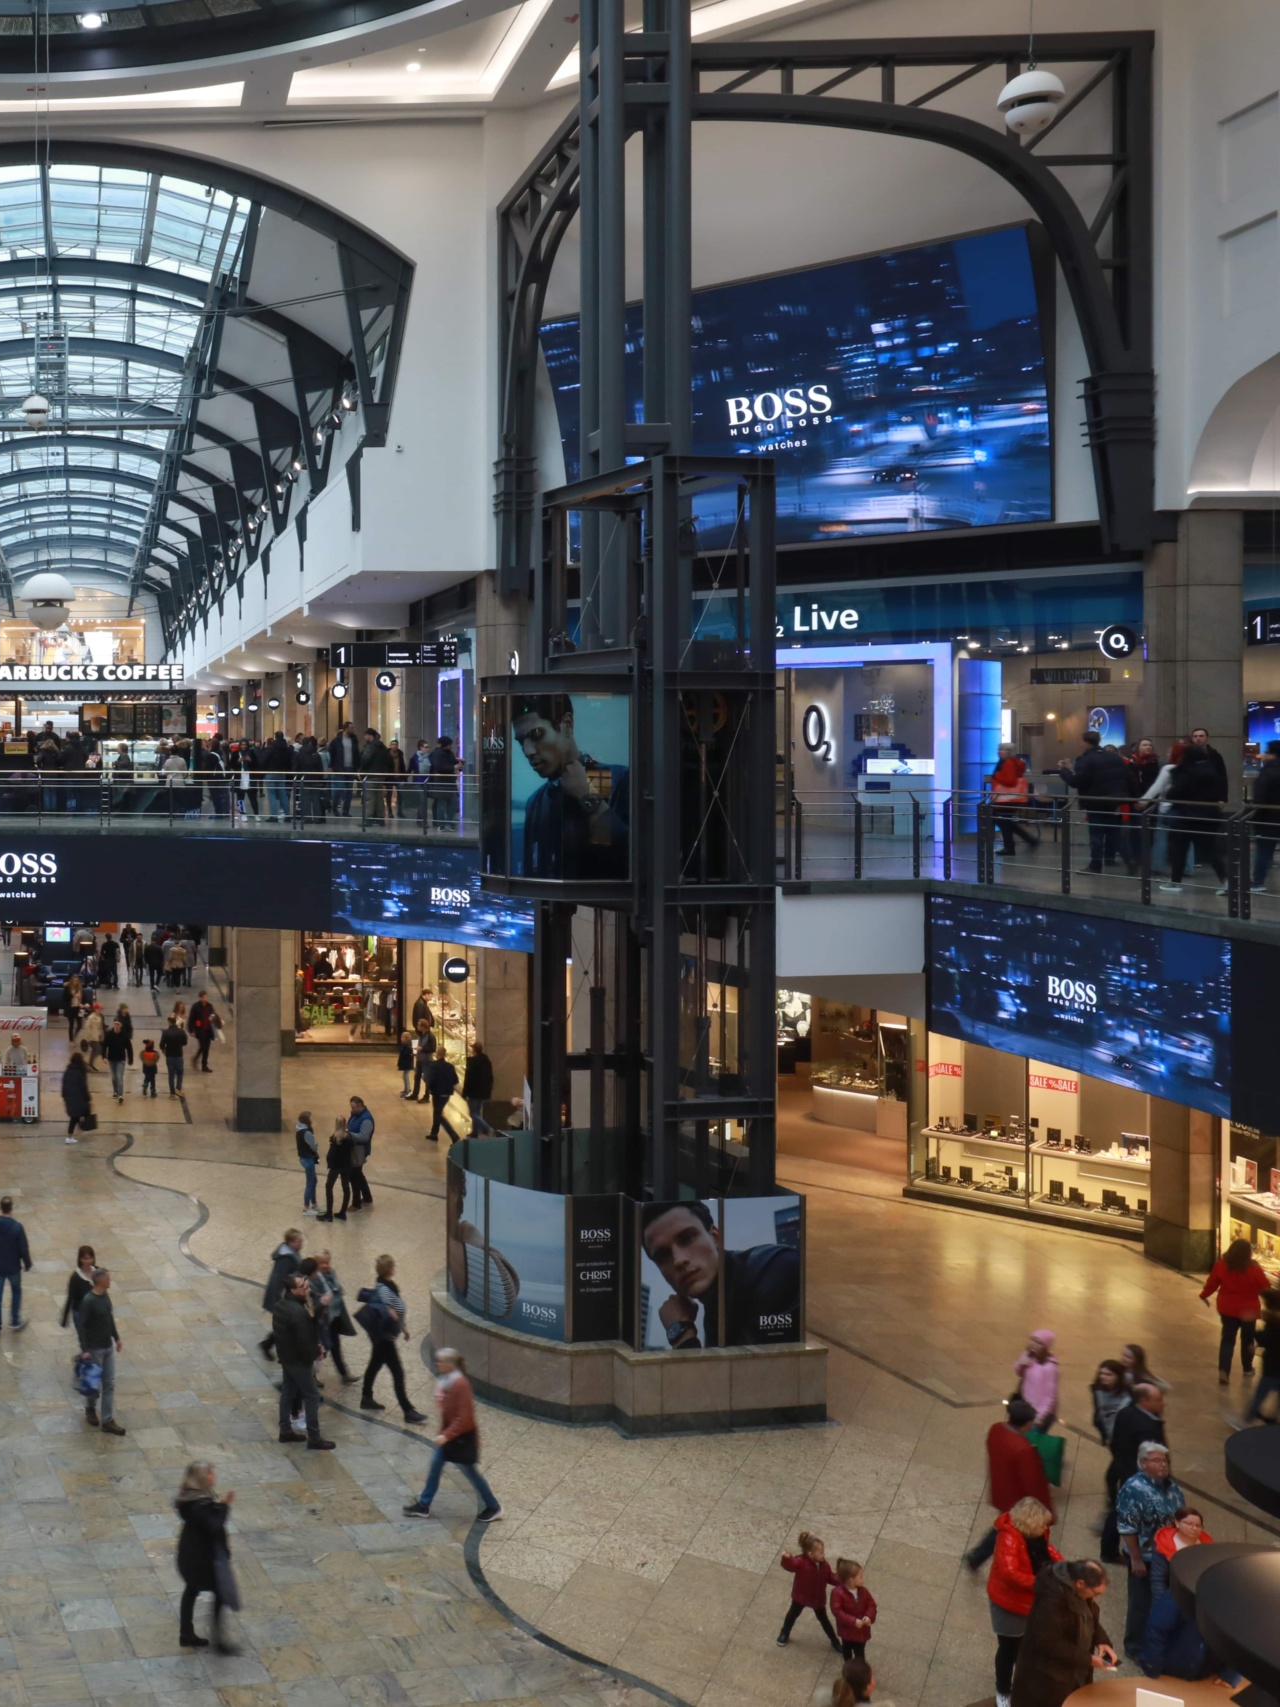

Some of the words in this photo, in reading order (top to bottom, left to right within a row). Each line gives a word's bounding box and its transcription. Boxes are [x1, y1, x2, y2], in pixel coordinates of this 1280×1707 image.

[725, 384, 832, 426] BOSS
[730, 423, 775, 436] HUGO
[786, 415, 833, 429] BOSS
[758, 439, 808, 452] watches
[794, 604, 859, 632] Live
[1252, 615, 1261, 640] 1
[336, 646, 345, 664] 1
[101, 665, 183, 681] COFFEE
[21, 876, 57, 884] BOSS
[431, 887, 471, 903] BOSS
[1047, 975, 1097, 1005] BOSS
[302, 1005, 335, 1019] SALE
[1060, 1013, 1084, 1024] watches
[1030, 1076, 1048, 1089] SALE
[1057, 1081, 1076, 1092] SALE
[580, 1229, 611, 1240] BOSS
[580, 1270, 612, 1280] CHRIST
[522, 1302, 557, 1320] BOSS
[759, 1313, 792, 1326] BOSS
